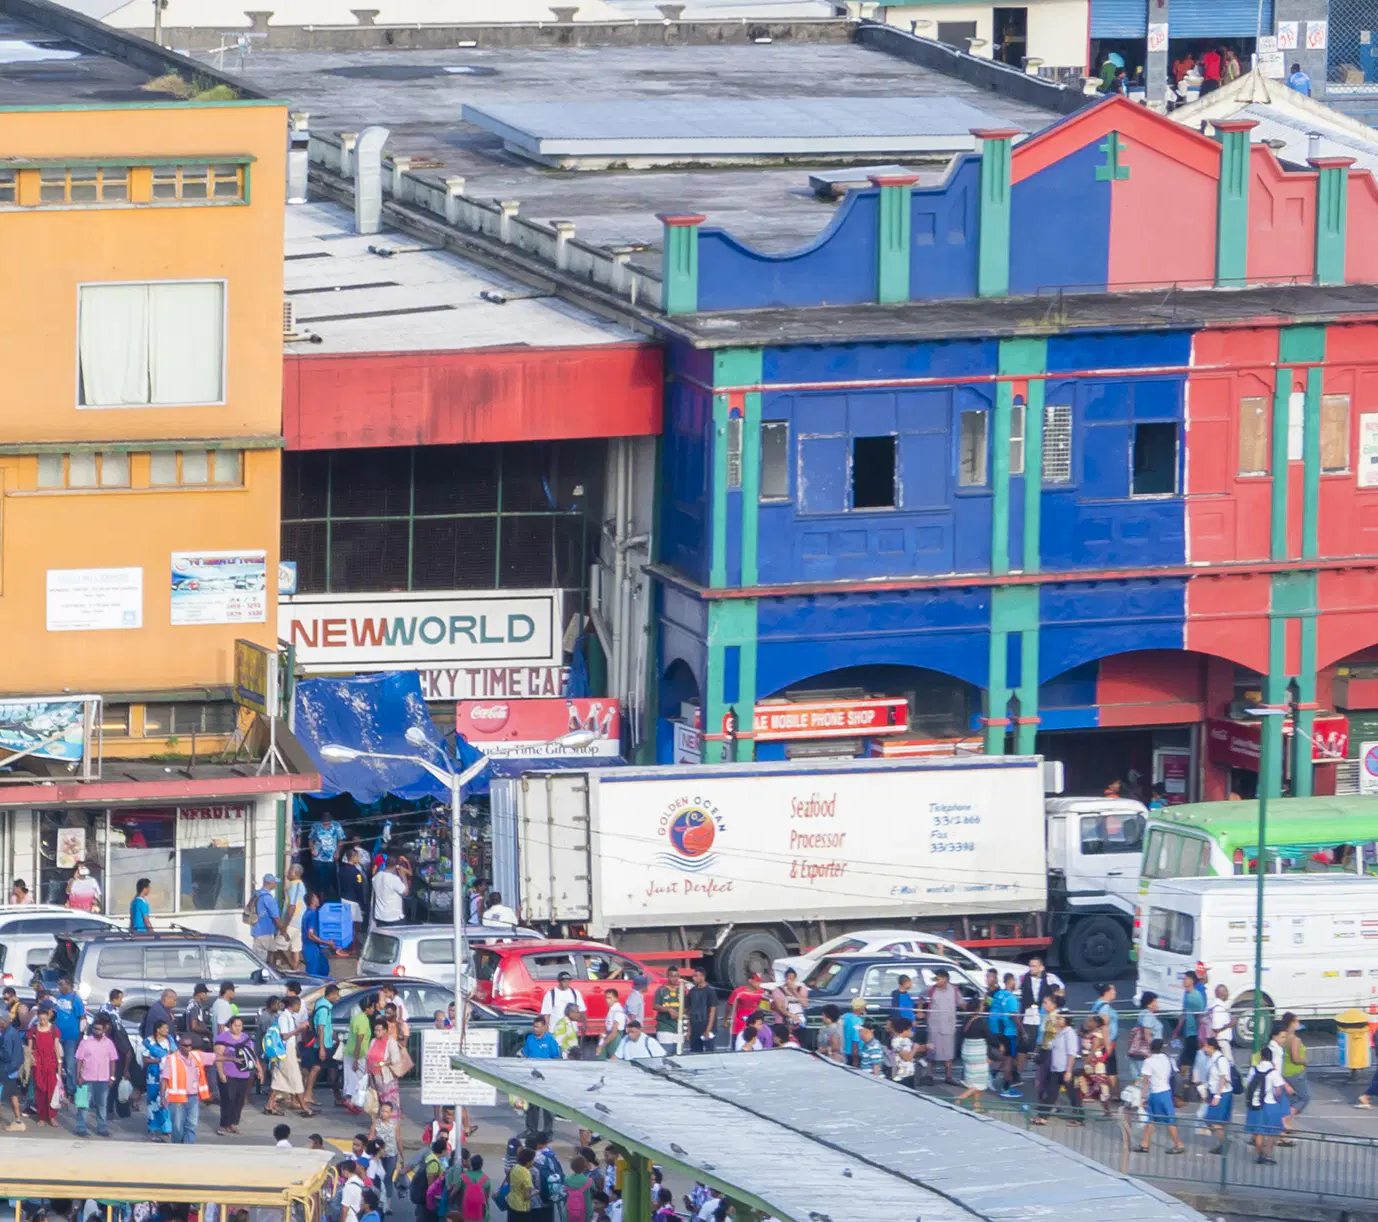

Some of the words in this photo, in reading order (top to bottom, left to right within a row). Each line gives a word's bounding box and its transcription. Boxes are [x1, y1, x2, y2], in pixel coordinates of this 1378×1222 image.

[466, 668, 521, 696] TIME
[771, 712, 808, 730] MOBILE
[811, 711, 846, 728] PHONE
[847, 709, 876, 727] SHOP
[658, 796, 689, 836] GOLDEN
[694, 796, 728, 832] OCEAN
[790, 793, 837, 819] Seafood
[790, 830, 847, 850] Processor
[801, 860, 848, 884] Exporter
[646, 880, 678, 897] Just
[684, 878, 734, 898] Perfect
